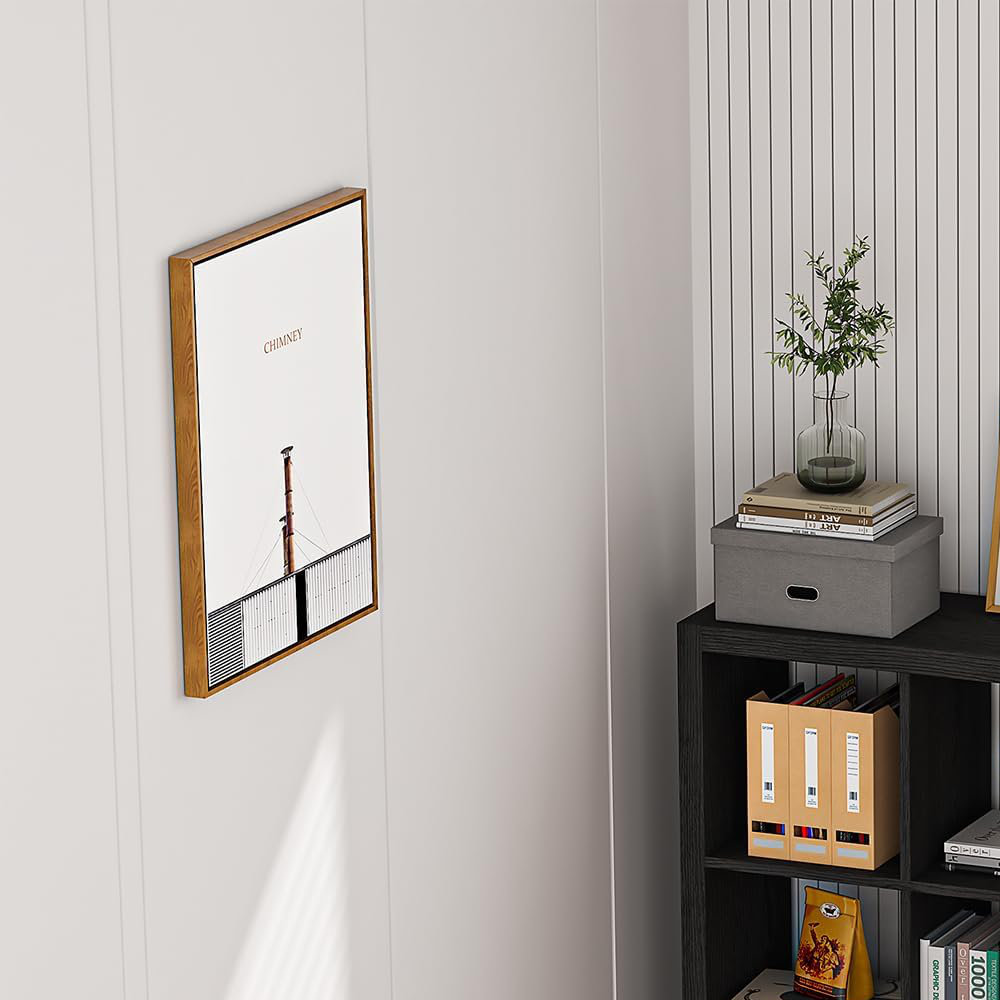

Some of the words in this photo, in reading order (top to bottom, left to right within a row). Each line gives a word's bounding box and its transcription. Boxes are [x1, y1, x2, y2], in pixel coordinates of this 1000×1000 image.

[263, 327, 303, 354] CHIMNEY
[820, 514, 841, 523] ART
[821, 523, 841, 531] ART
[932, 959, 940, 991] GRAPHIC
[971, 955, 986, 999] 1000
